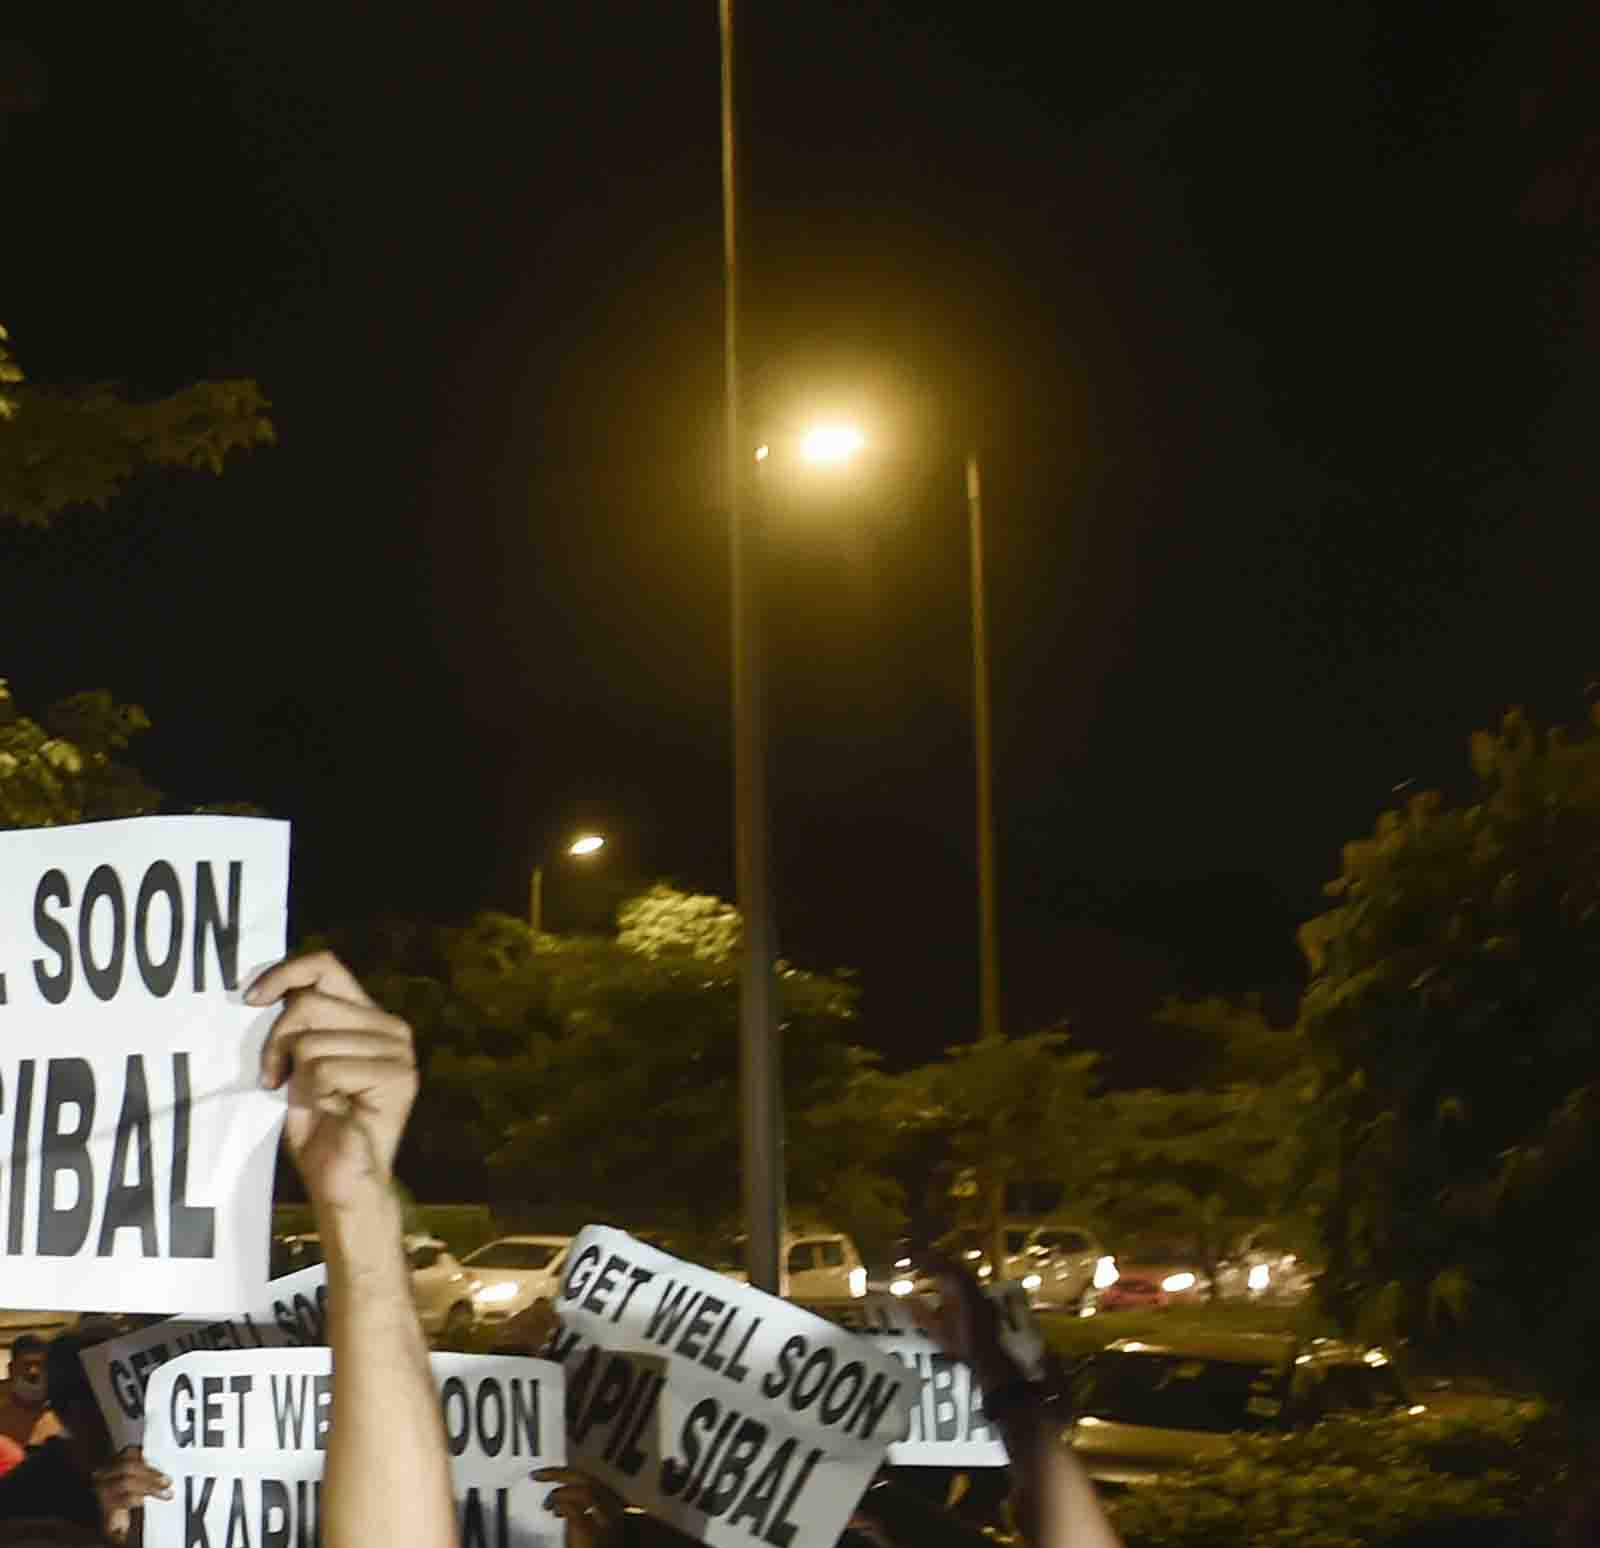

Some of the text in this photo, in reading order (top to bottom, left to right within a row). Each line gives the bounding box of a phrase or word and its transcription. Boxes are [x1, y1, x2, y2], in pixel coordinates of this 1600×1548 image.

[32, 858, 244, 1004] SOON
[170, 1372, 542, 1458] GET WE OON
[564, 1245, 901, 1440] GET WELL SOON
